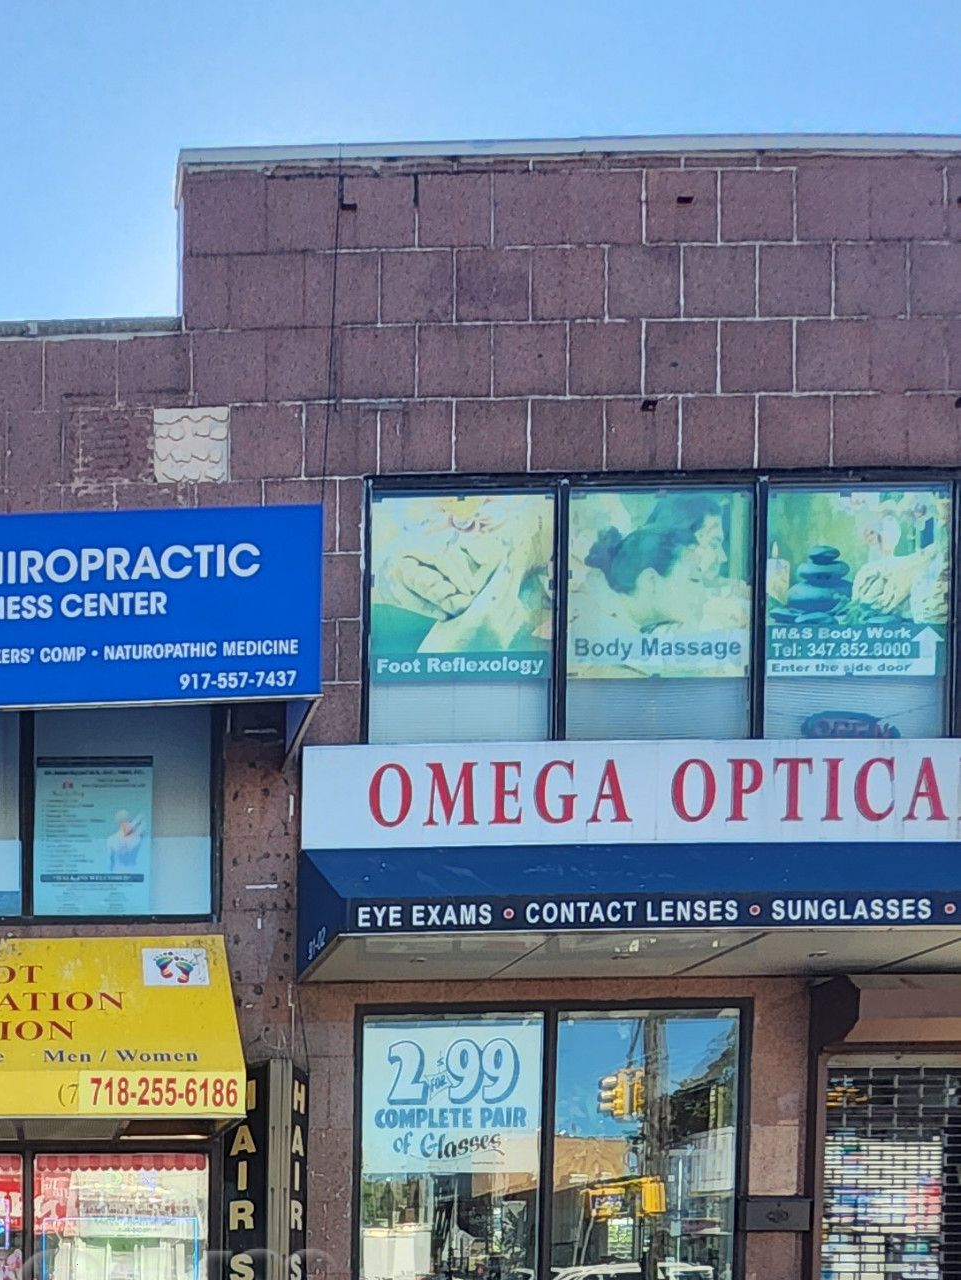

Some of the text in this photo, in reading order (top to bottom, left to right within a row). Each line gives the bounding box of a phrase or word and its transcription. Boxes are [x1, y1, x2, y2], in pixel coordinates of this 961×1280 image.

[60, 591, 167, 618] CENTER
[772, 627, 911, 641] M&S Body Work
[40, 646, 86, 663] COMP
[104, 641, 216, 660] NATUROPATHIC
[223, 639, 298, 656] MEDICINE
[575, 638, 741, 661] Body Massage
[772, 643, 801, 657] Tel:
[377, 656, 543, 677] Foot Reflexology
[772, 663, 810, 672] Enter
[815, 663, 838, 672] the
[878, 663, 911, 672] door
[179, 670, 297, 690] 917-557-7437
[368, 756, 961, 828] OMEGA OPTICA
[357, 898, 932, 928] EYE EXAMS CONTACT LENSES SUNGLASSES
[43, 1049, 92, 1063] Men
[115, 1049, 198, 1063] Women
[388, 1038, 520, 1105] 2 99
[91, 1077, 238, 1107] 718-255-6186
[374, 1107, 527, 1129] COMPLETE PAIR
[290, 1079, 306, 1233] HAIR
[393, 1131, 502, 1159] of Glasses
